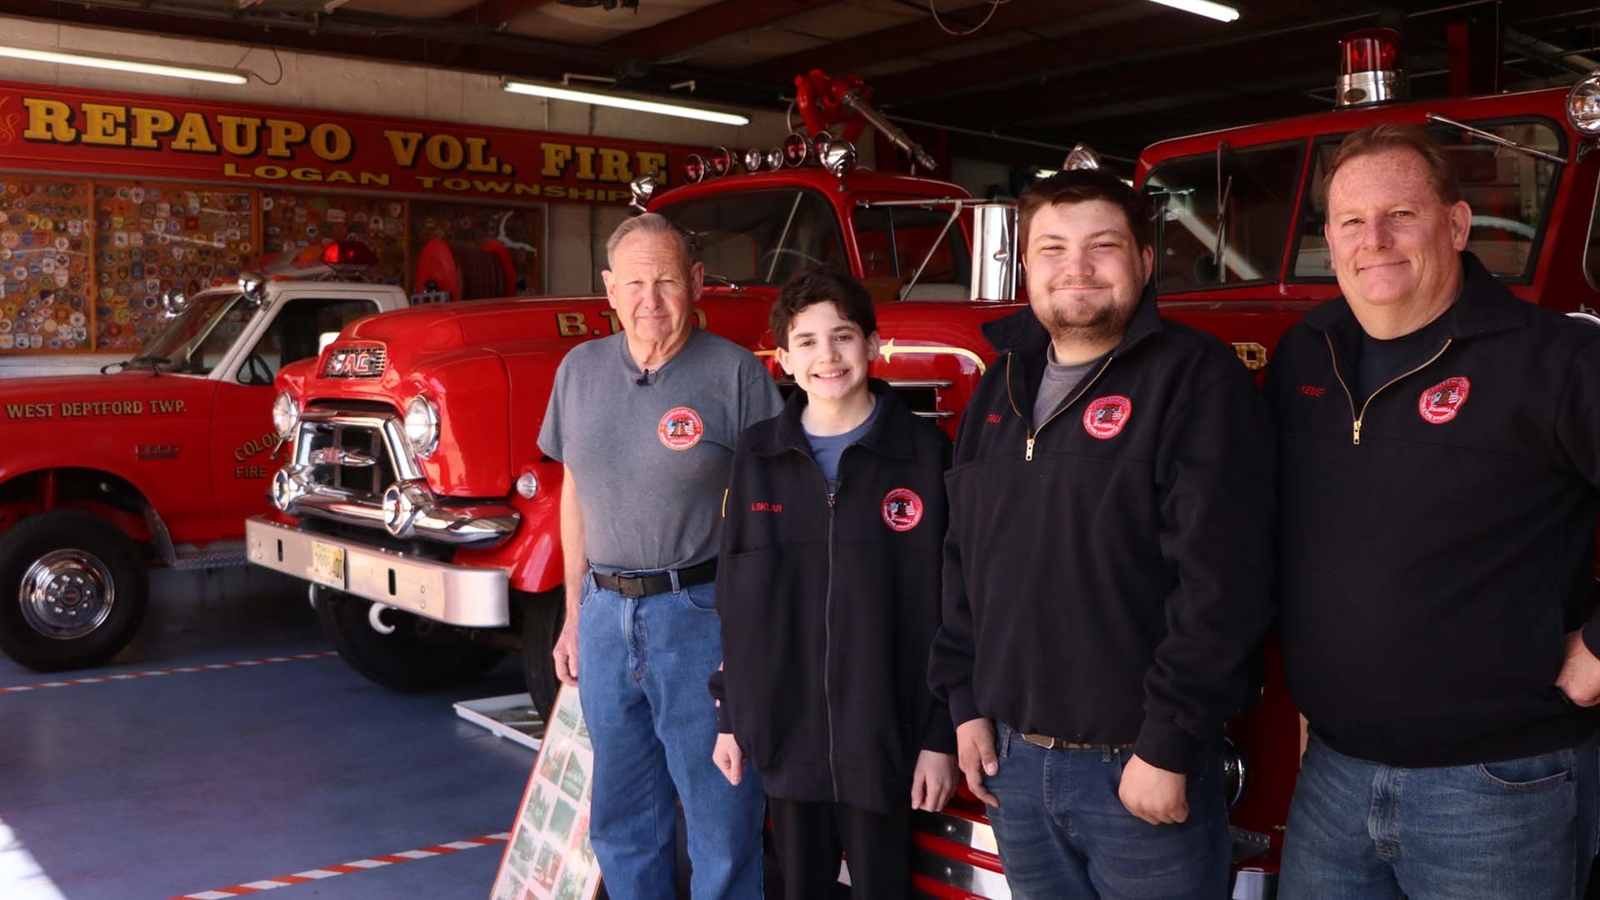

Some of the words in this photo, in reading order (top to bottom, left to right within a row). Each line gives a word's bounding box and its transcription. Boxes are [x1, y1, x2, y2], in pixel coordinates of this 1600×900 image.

[23, 97, 353, 162] REPAUPO
[384, 129, 514, 175] VOL.
[541, 142, 667, 186] FIRE
[223, 163, 392, 185] LOGAN
[415, 176, 630, 201] TOWNSHIP
[7, 403, 54, 418] WEST
[61, 400, 143, 417] DEPTFORD
[149, 399, 187, 413] TWP.
[235, 466, 268, 478] FIRE
